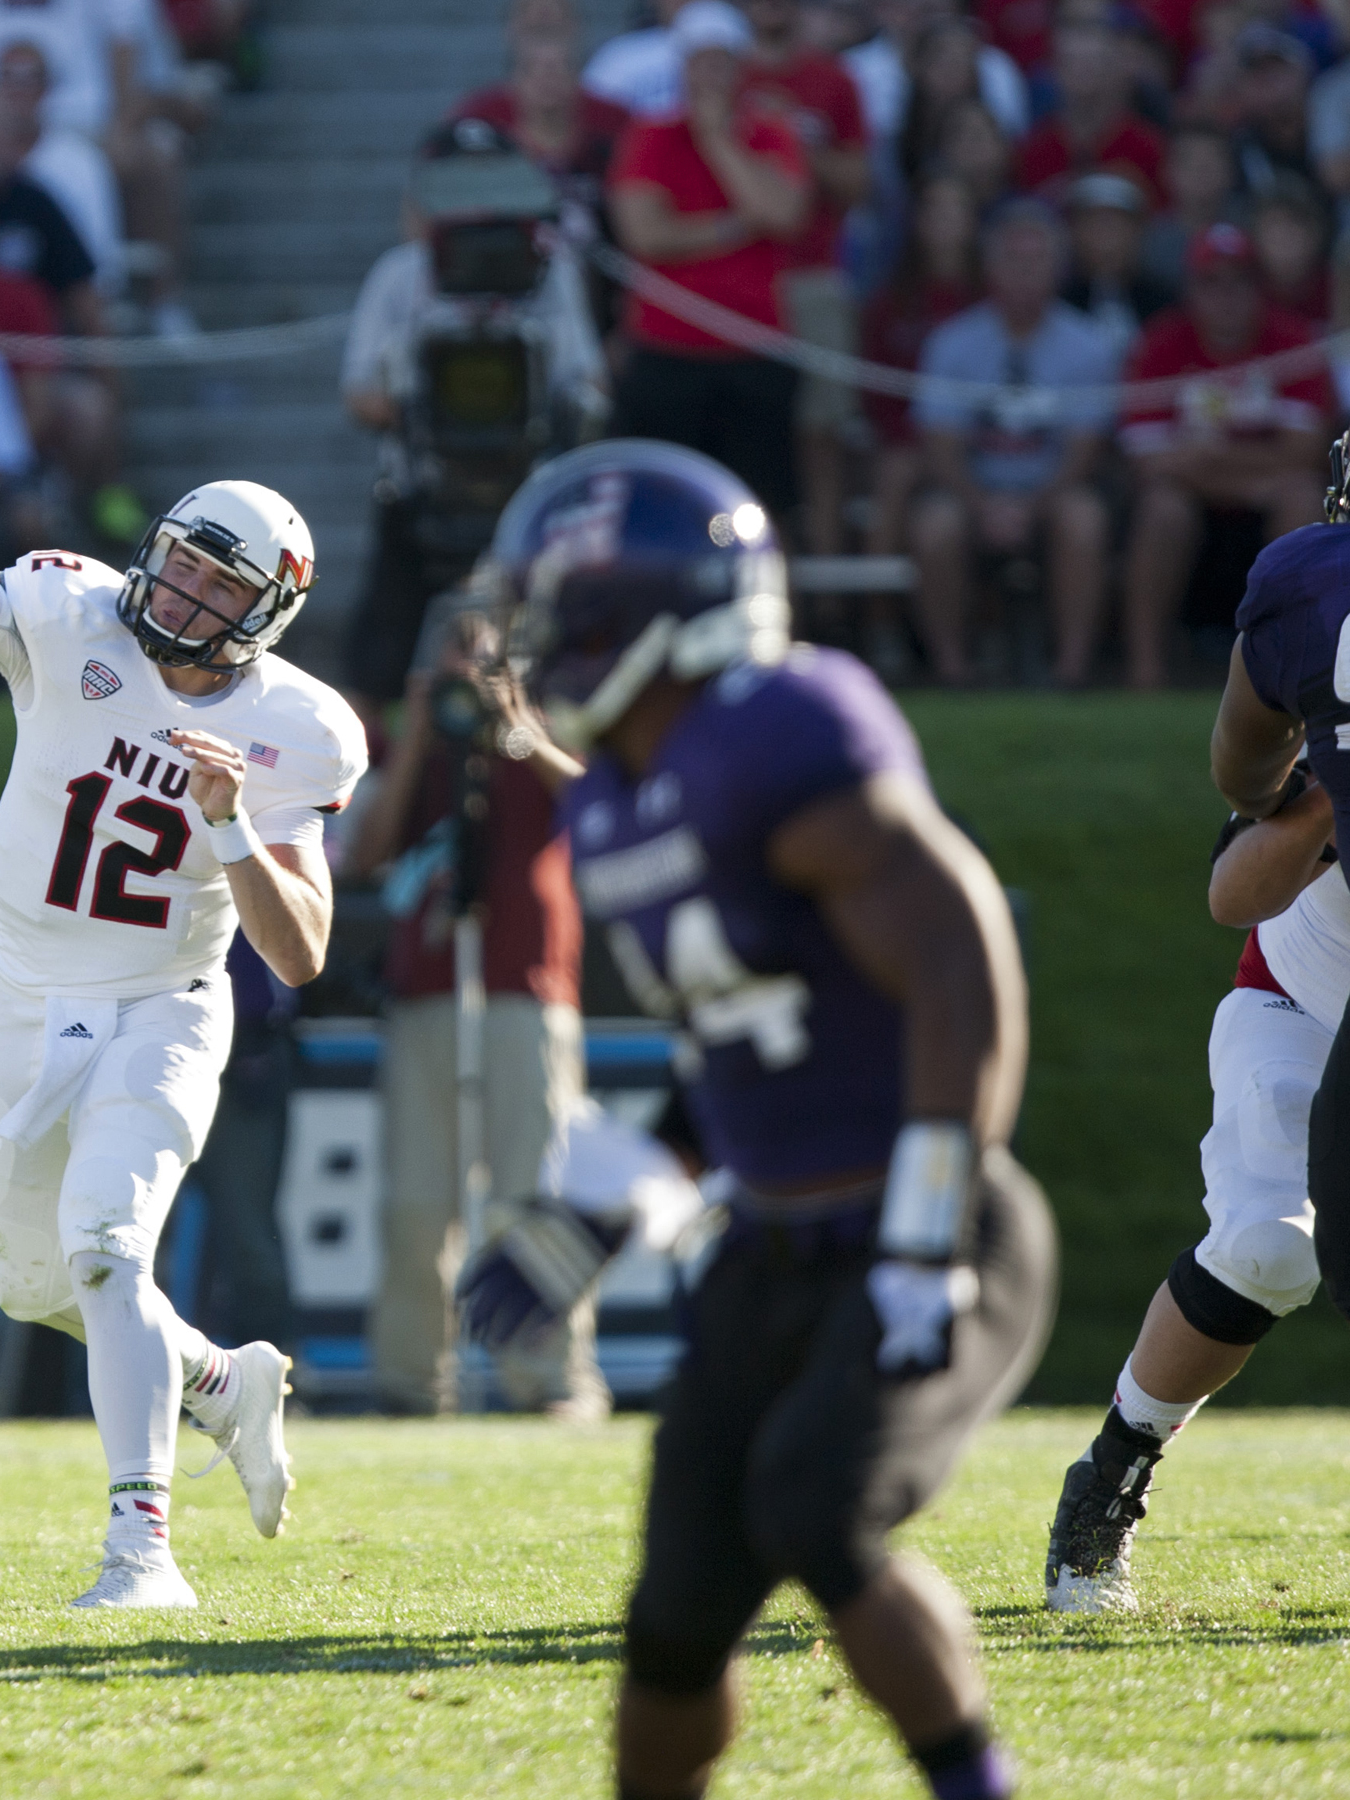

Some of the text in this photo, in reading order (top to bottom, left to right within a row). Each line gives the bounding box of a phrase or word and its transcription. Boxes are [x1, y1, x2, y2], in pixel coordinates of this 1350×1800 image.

[83, 668, 116, 695] MAC
[103, 736, 190, 800] NIU
[45, 770, 191, 929] 12
[59, 1028, 94, 1039] adidas
[110, 1482, 158, 1494] SPEED
